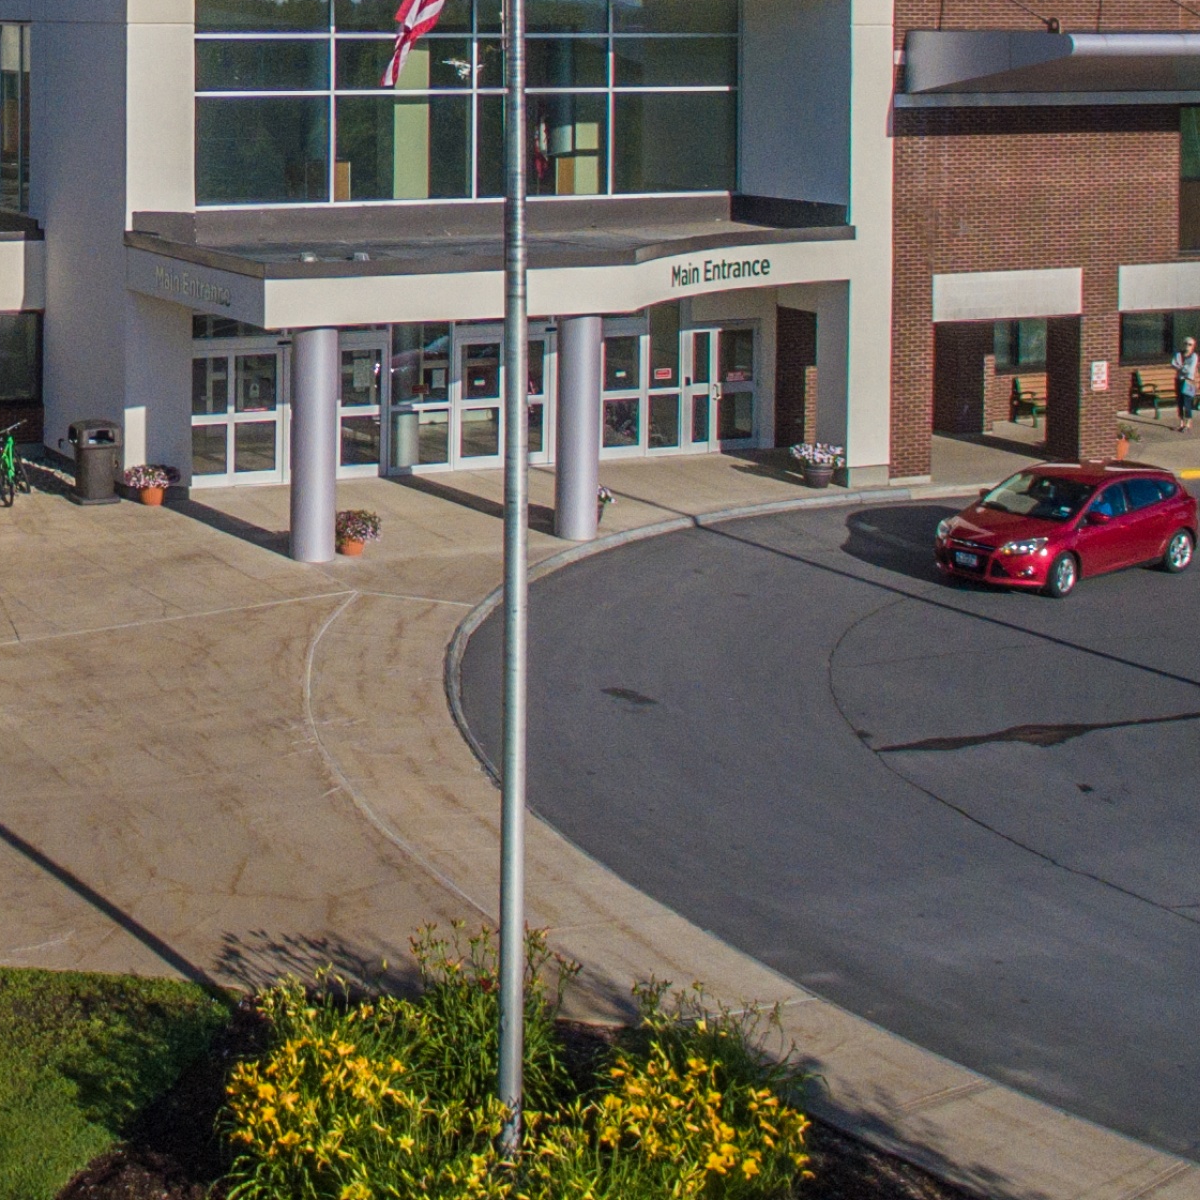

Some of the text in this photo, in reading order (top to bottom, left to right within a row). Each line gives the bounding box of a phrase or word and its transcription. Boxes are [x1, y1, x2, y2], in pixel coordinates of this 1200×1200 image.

[155, 266, 181, 293] Main
[671, 259, 771, 287] Main Entrance
